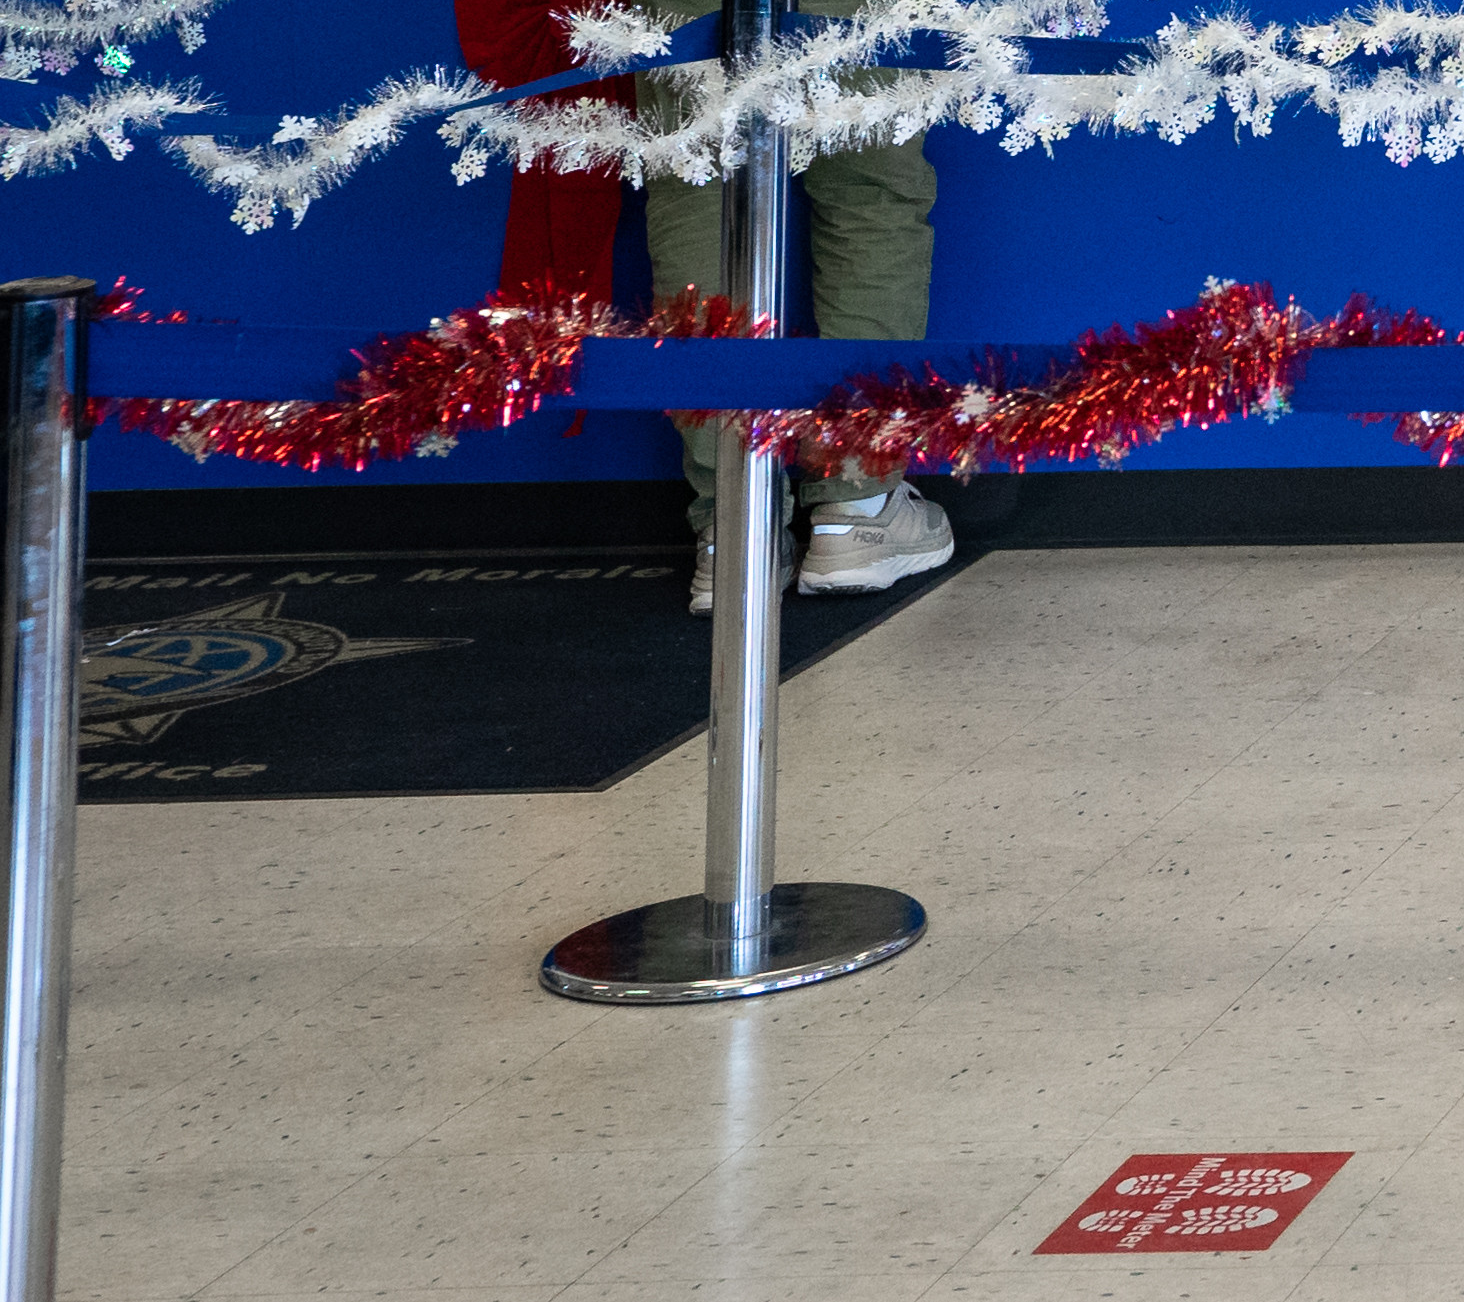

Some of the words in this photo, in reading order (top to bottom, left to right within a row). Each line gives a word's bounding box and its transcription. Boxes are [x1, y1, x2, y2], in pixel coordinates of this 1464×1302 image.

[84, 573, 252, 589] Mail
[270, 570, 378, 585] No
[402, 565, 675, 582] Morale
[80, 759, 268, 781] ffice
[1175, 1157, 1227, 1187] Mind
[1153, 1188, 1197, 1211] The
[1116, 1212, 1173, 1249] Meter
